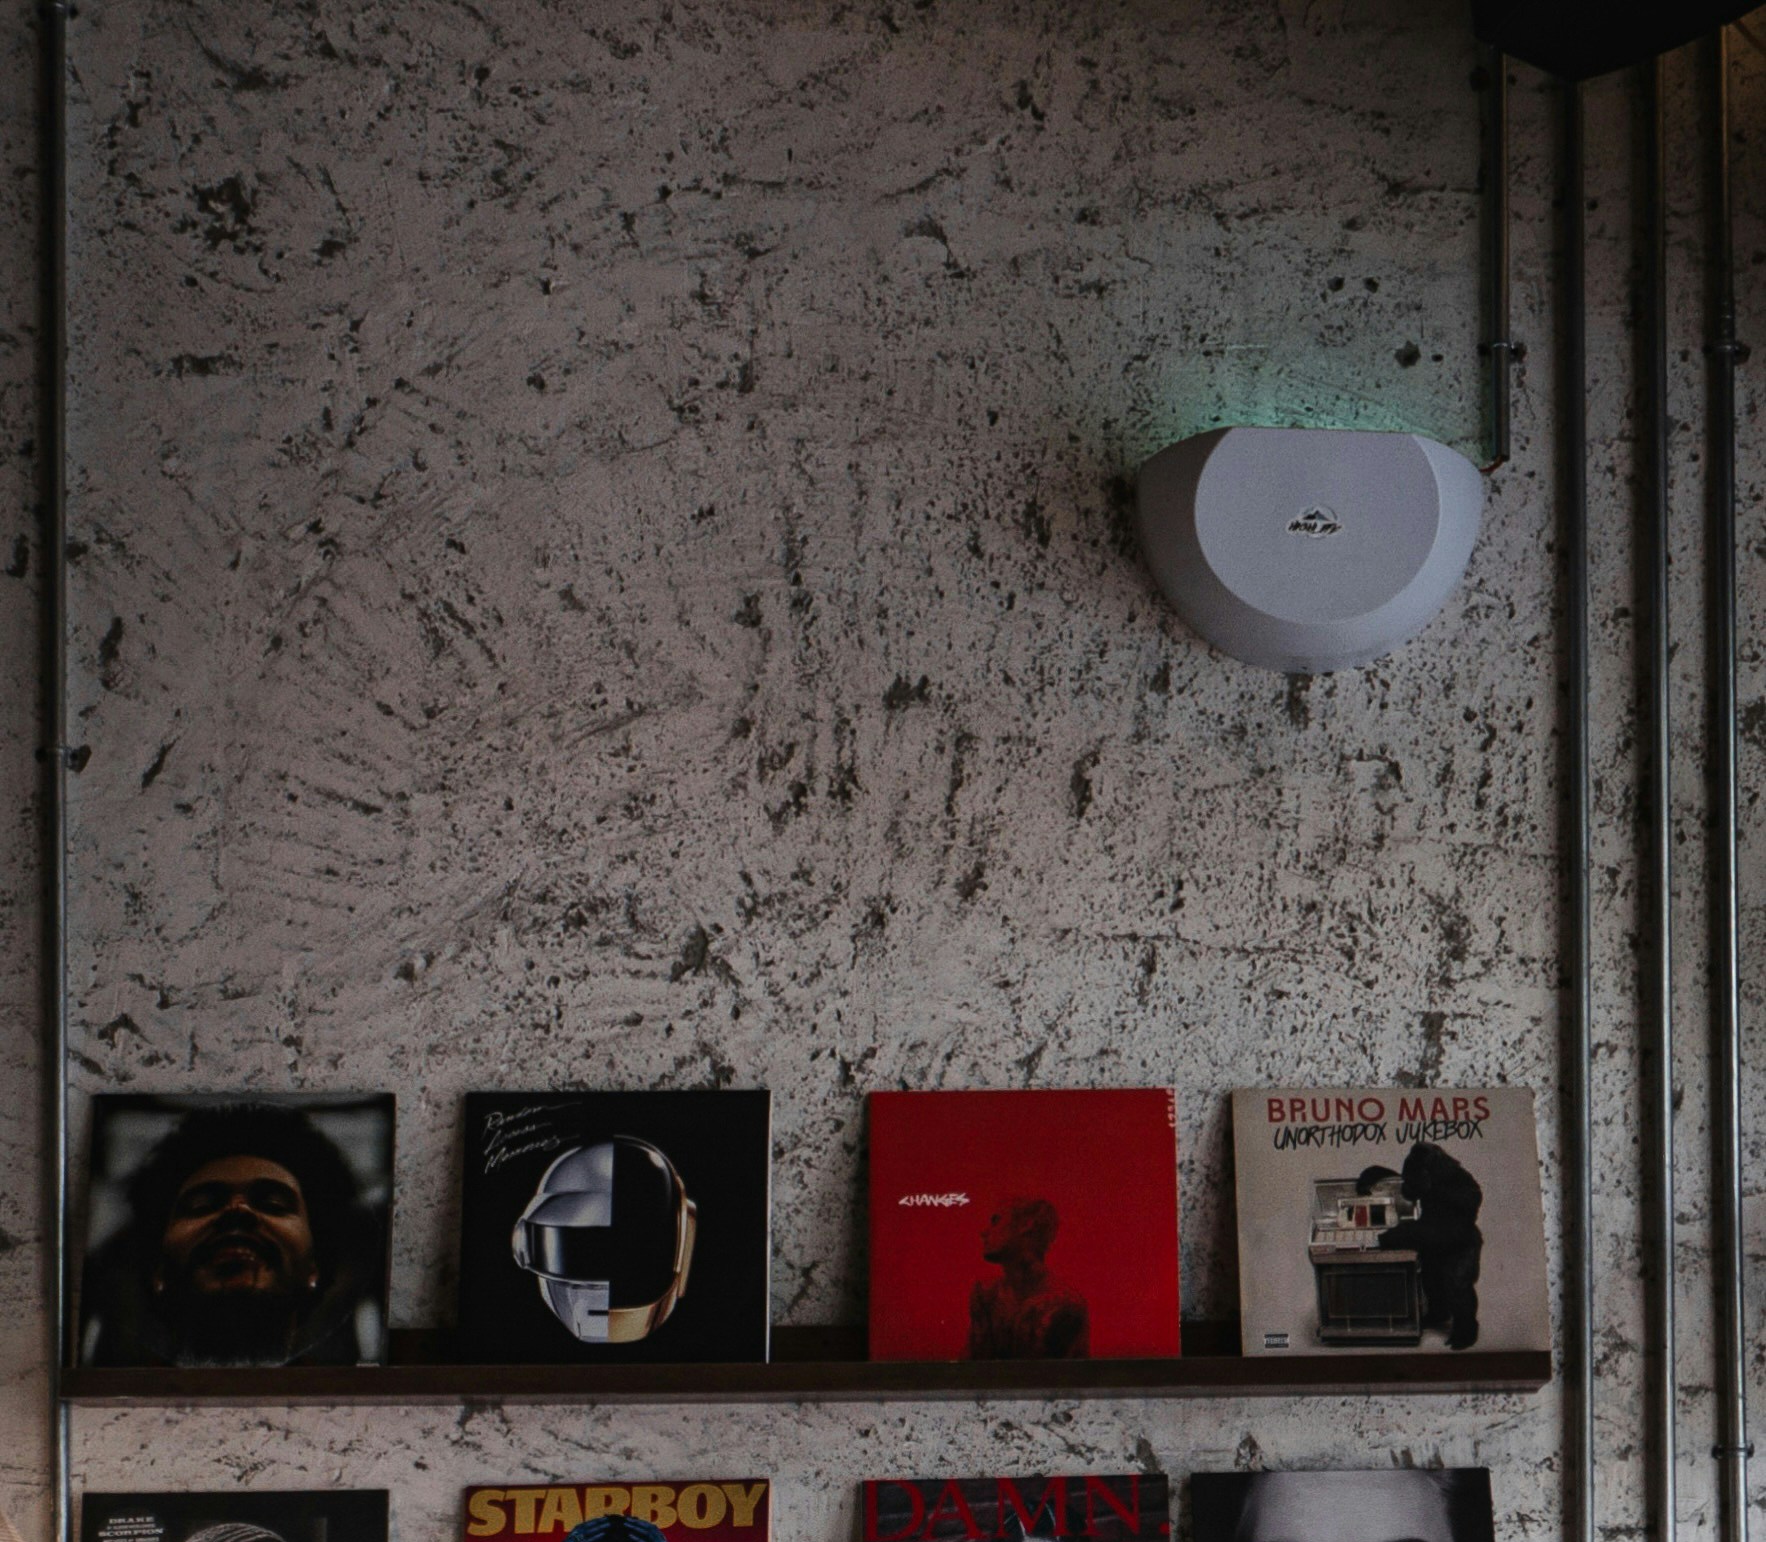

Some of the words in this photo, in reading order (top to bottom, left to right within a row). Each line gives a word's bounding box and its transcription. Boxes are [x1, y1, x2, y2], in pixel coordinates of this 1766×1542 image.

[1267, 1098, 1384, 1123] BRUNO
[1399, 1096, 1490, 1121] MARS
[1274, 1122, 1386, 1150] UNORTHODOX
[1396, 1119, 1483, 1144] JUKEBOX
[898, 1192, 970, 1207] CHANGES
[466, 1483, 768, 1537] STARBOY
